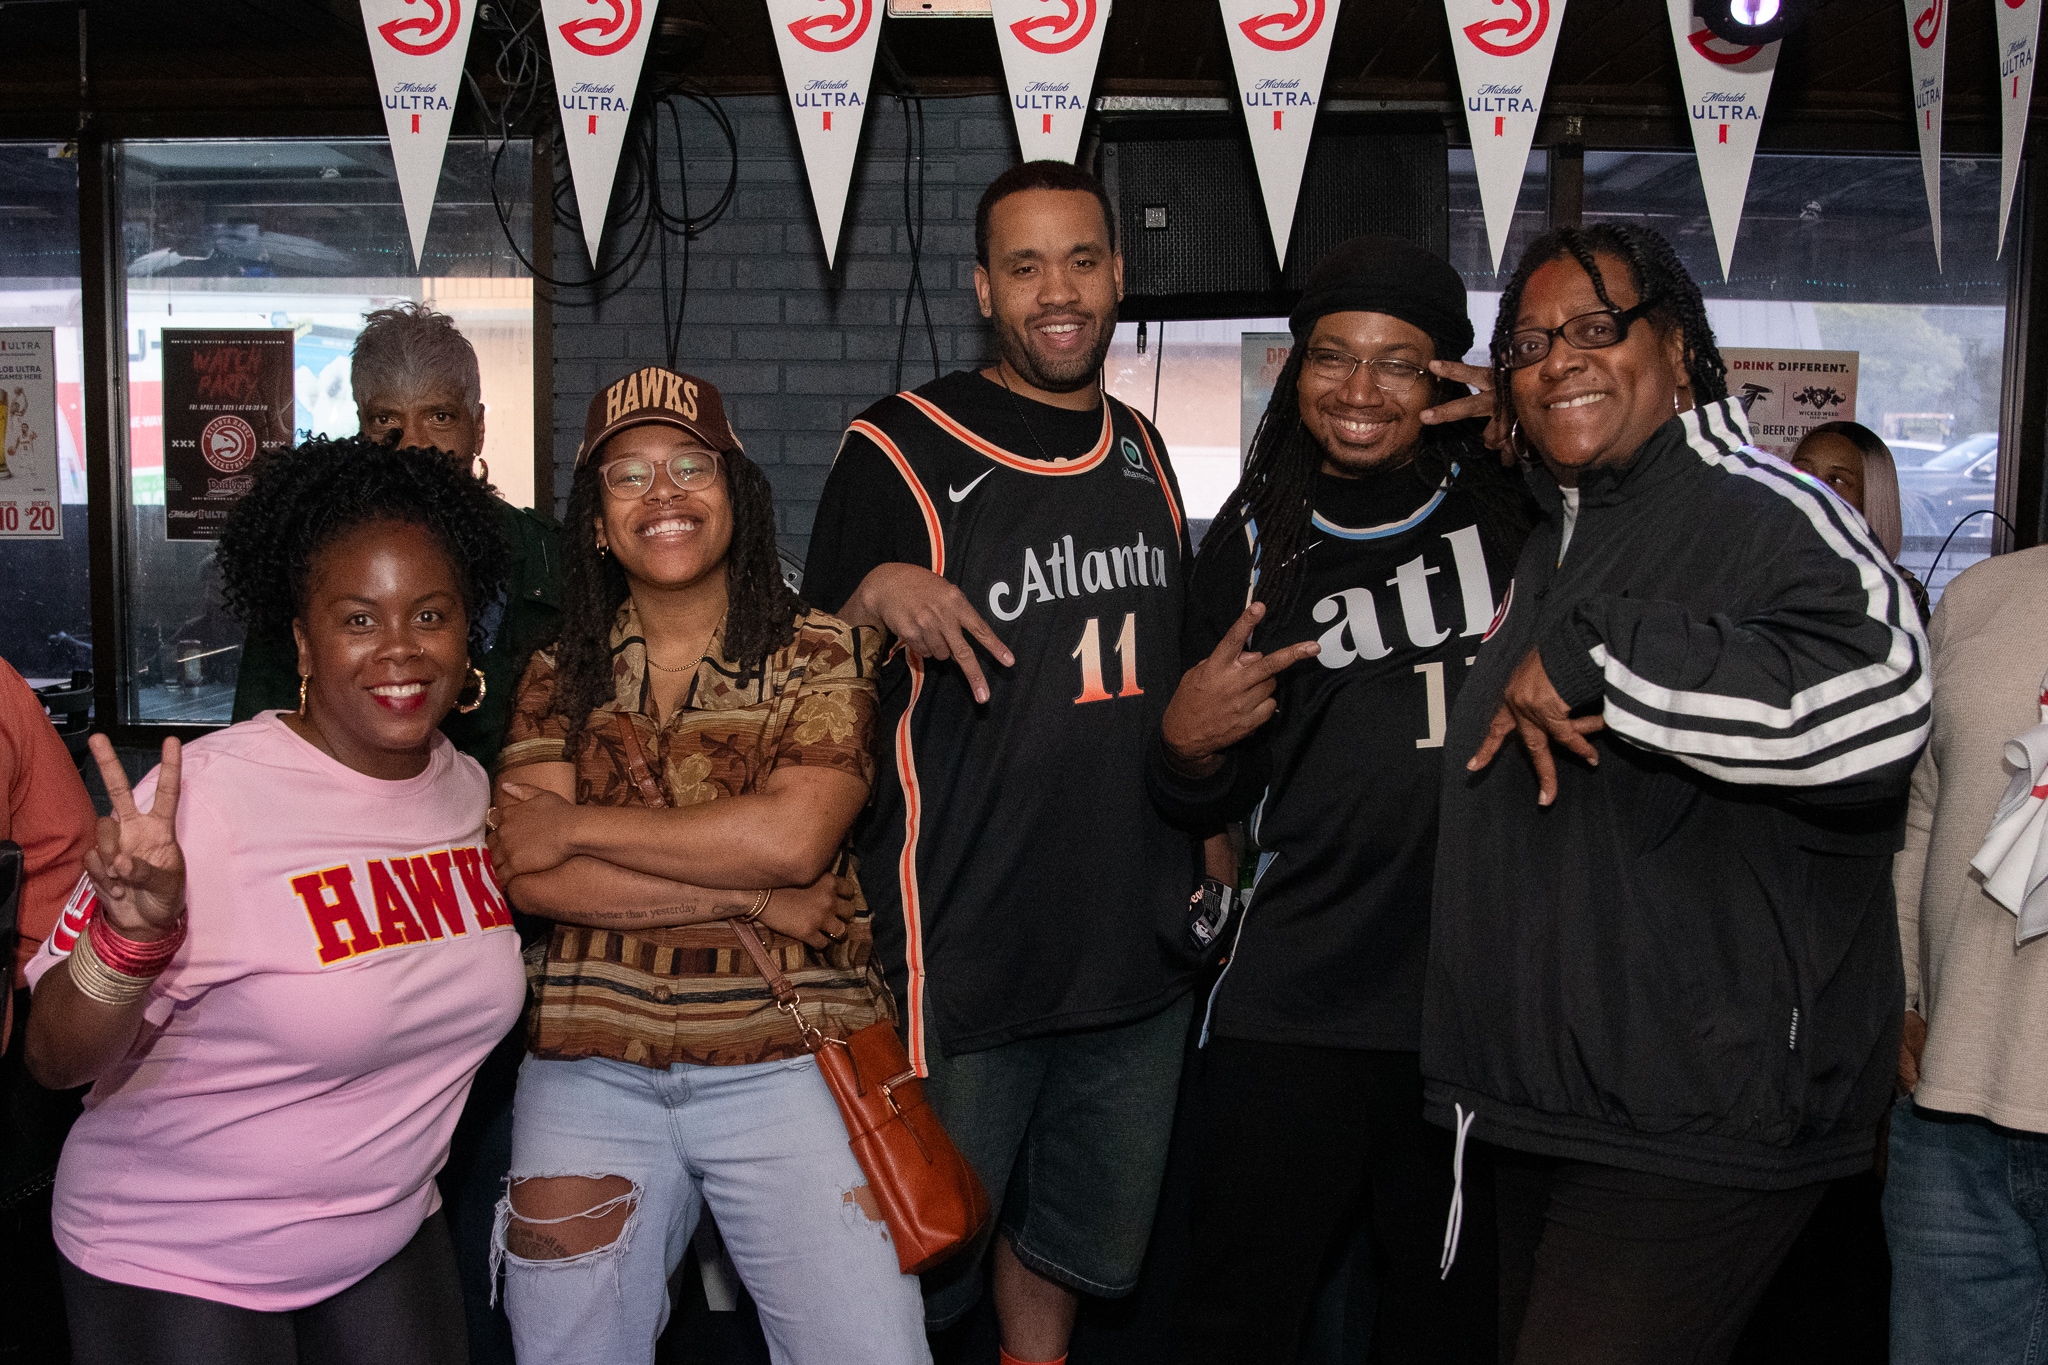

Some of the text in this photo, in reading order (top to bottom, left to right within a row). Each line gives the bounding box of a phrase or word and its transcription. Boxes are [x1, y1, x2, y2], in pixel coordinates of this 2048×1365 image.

[2002, 48, 2032, 77] ULTRA
[394, 82, 437, 93] Michelob
[572, 82, 615, 94] Michelob
[804, 79, 848, 91] Michelob
[1025, 81, 1069, 93] Michelob
[1254, 79, 1301, 90] Michelob
[1477, 83, 1522, 95] Michelob
[385, 95, 449, 110] ULTRA
[562, 95, 625, 112] ULTRA
[795, 93, 861, 107] ULTRA
[1015, 95, 1081, 109] ULTRA
[1246, 92, 1312, 106] ULTRA
[1468, 97, 1534, 112] ULTRA
[1702, 91, 1746, 104] Michelob
[1916, 87, 1940, 109] ULTRA
[1693, 105, 1758, 119] ULTRA
[8, 342, 41, 350] ULTRA
[1733, 360, 1849, 373] DRINK DIFFERENT.
[605, 366, 699, 427] HAWKS
[205, 418, 231, 439] ATLANTA
[1763, 425, 1785, 435] BEER
[1788, 425, 1799, 435] OF
[204, 510, 228, 519] ULTR
[988, 531, 1168, 622] Atlanta
[1312, 524, 1496, 669] atl
[1070, 612, 1145, 704] 11
[595, 910, 623, 919] better
[625, 909, 648, 918] than
[650, 903, 697, 919] yesterday
